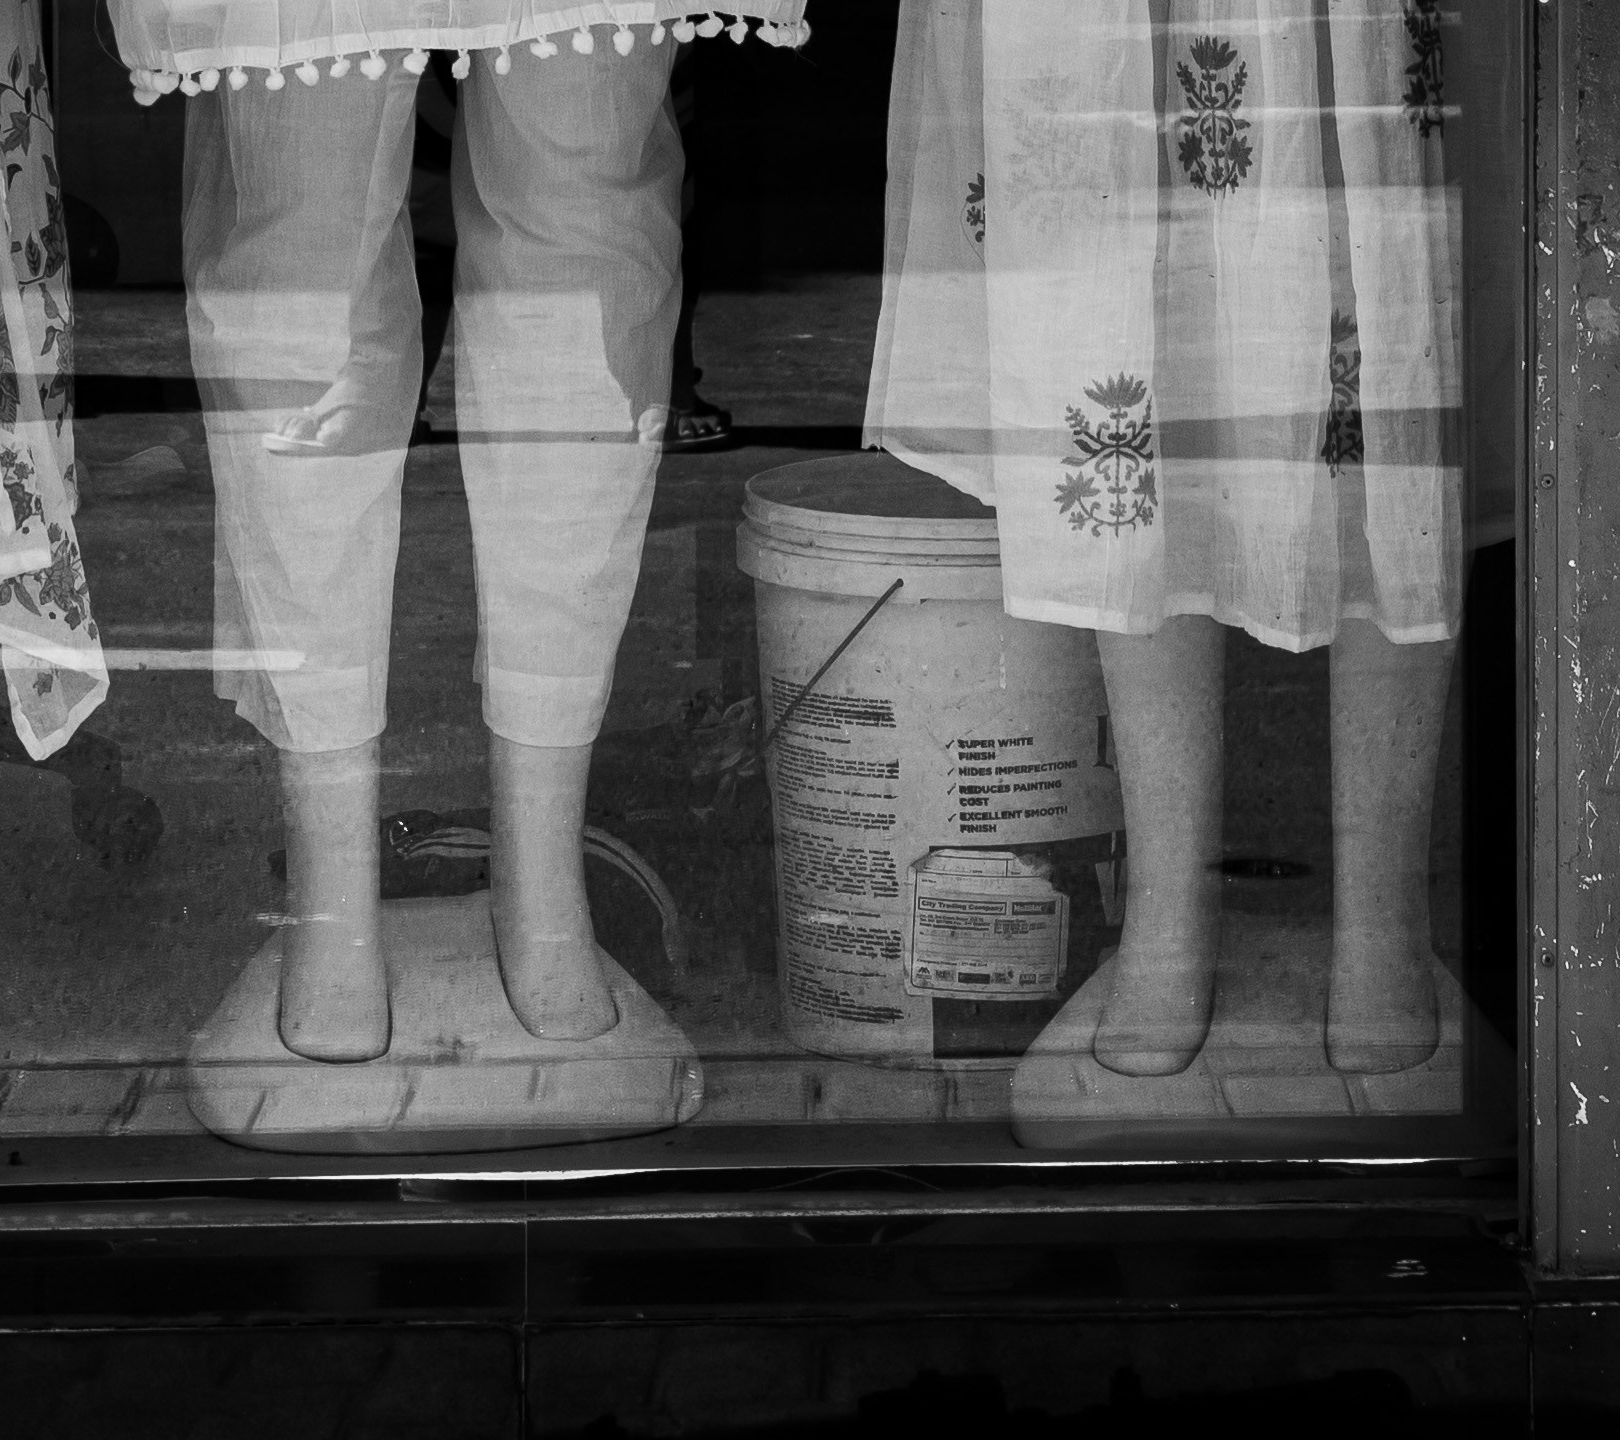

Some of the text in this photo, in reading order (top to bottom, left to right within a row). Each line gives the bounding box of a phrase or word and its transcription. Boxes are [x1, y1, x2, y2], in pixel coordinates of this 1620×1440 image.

[957, 737, 1034, 749] SUPER WHITE
[958, 752, 996, 760] FINISH
[958, 760, 1077, 776] HIDES IMPERFECTIONS
[958, 780, 1062, 794] REDUCES PAINTING
[959, 797, 989, 806] COST
[959, 805, 1068, 821] EXCELLENT SMOOTH
[960, 824, 997, 833] FINISH
[921, 900, 936, 909] City
[968, 904, 1004, 912] Company
